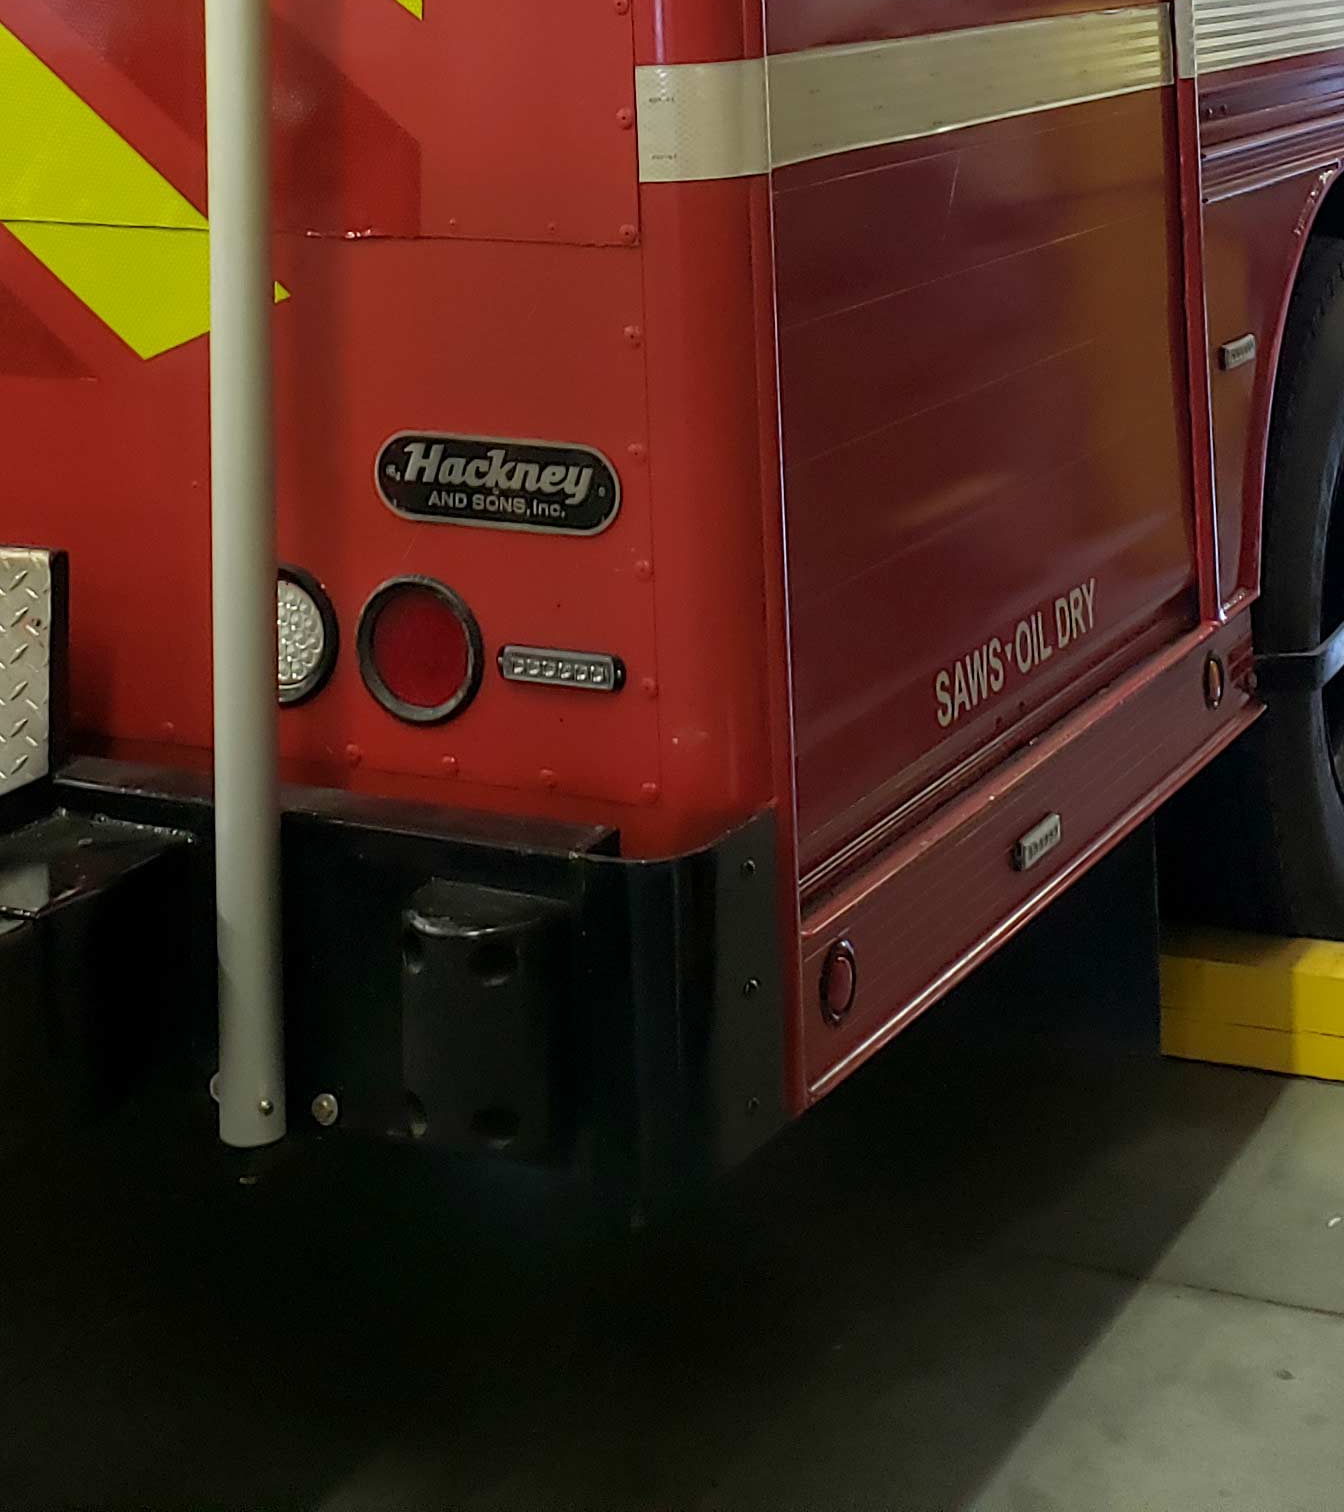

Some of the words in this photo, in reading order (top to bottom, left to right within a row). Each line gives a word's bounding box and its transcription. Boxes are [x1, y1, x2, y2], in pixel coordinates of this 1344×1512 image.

[403, 442, 593, 505] Hackney
[428, 491, 467, 508] AND
[1015, 611, 1053, 673] OIL
[1055, 578, 1095, 649] DRY
